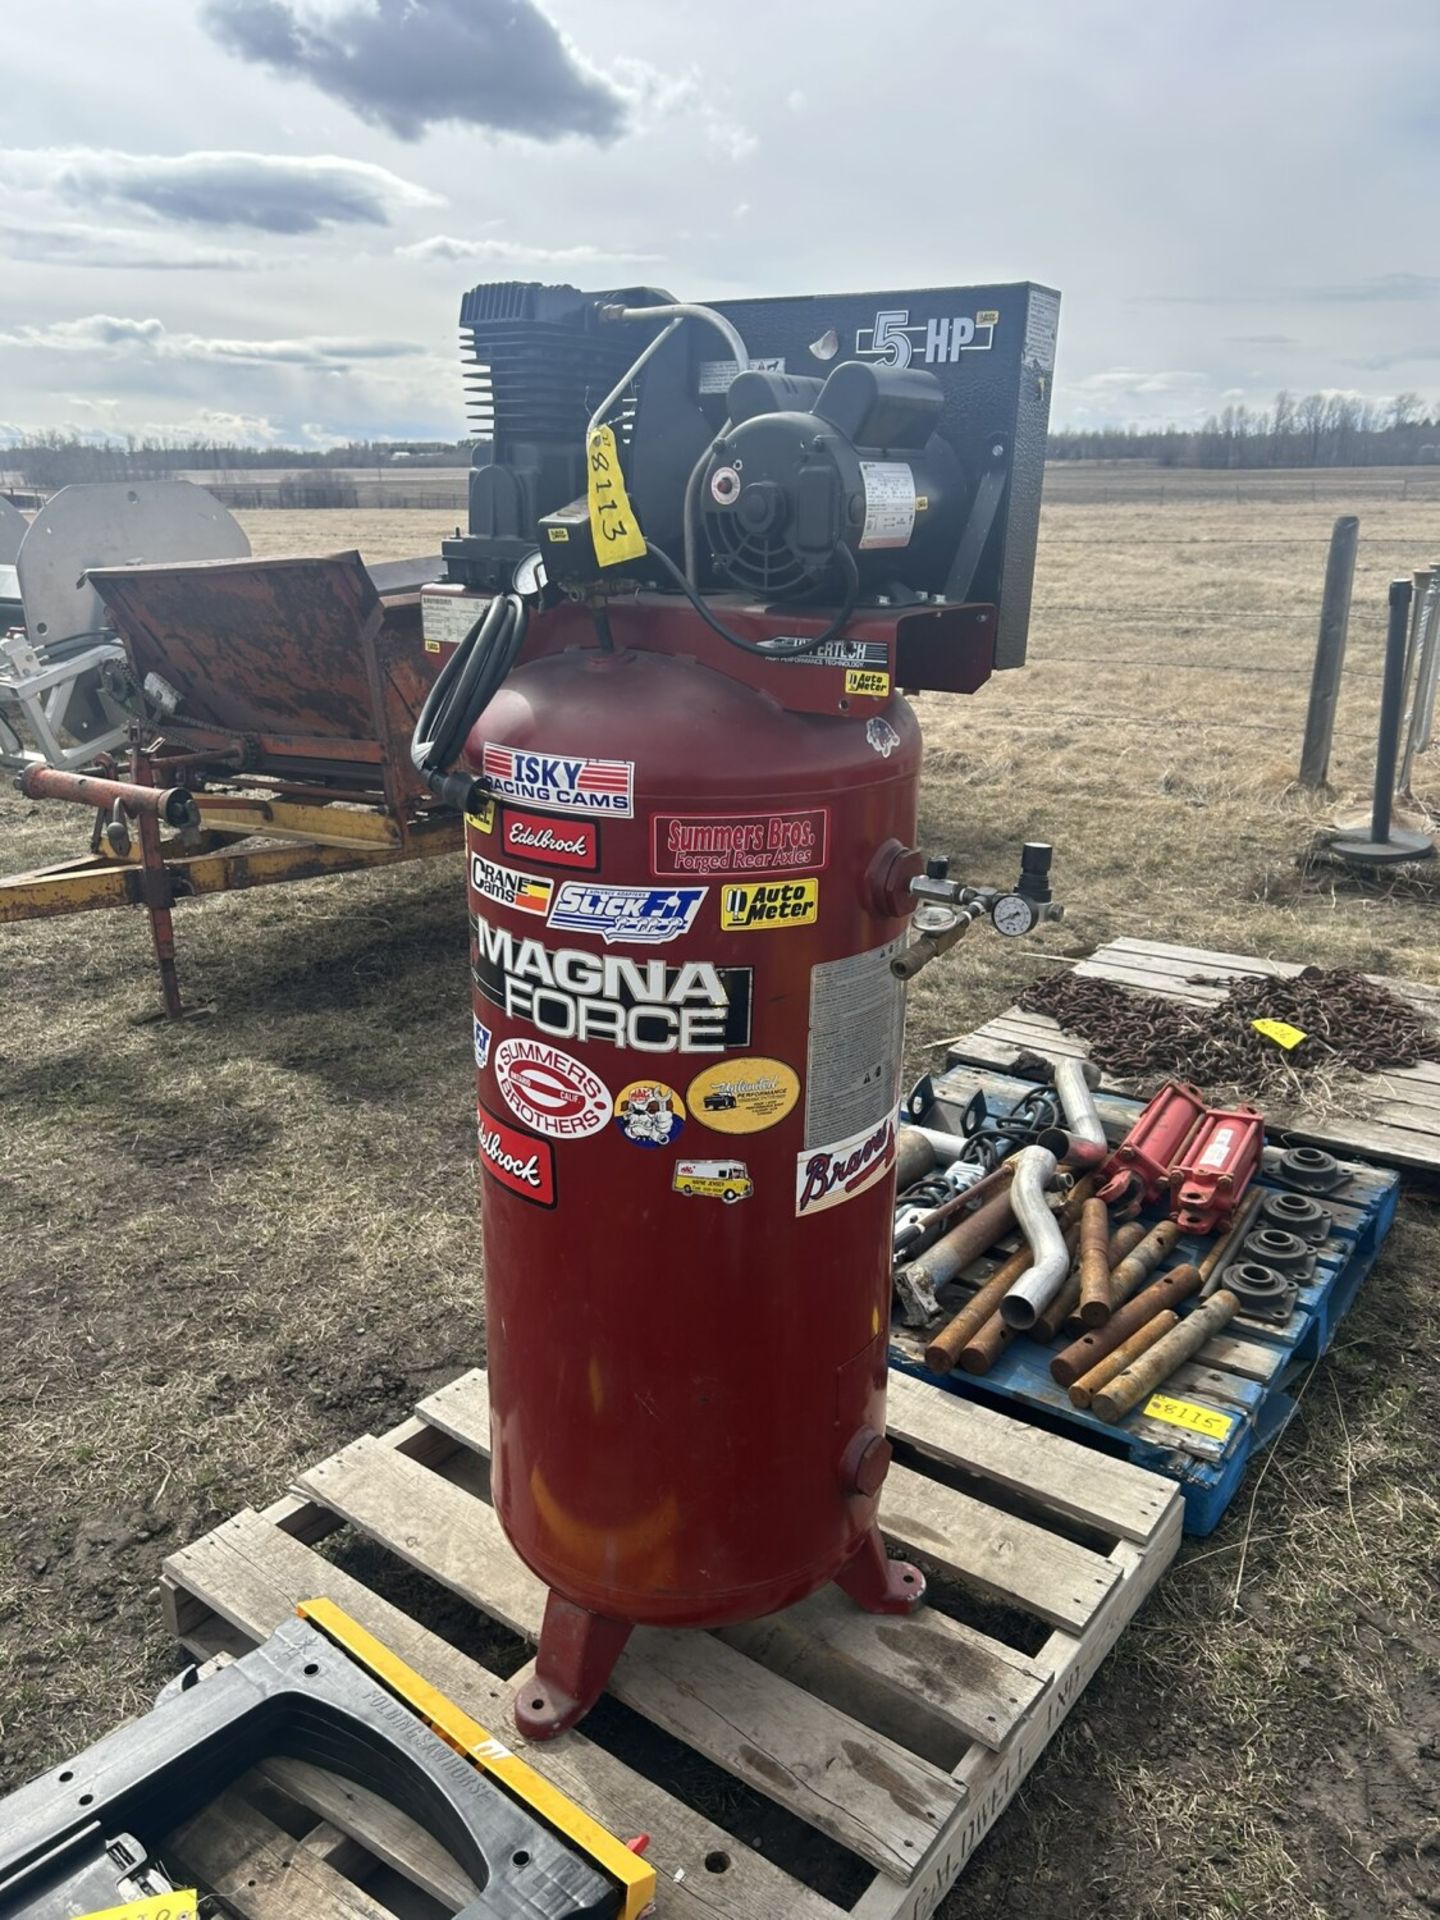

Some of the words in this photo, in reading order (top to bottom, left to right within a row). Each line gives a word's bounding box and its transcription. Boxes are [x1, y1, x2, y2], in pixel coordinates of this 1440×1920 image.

[872, 310, 912, 369] 5
[925, 317, 975, 363] HP
[591, 452, 627, 541] 8113
[856, 682, 887, 692] Meter
[859, 673, 883, 683] Auto
[514, 754, 582, 790] ISKY
[556, 790, 628, 809] CAMS
[508, 822, 587, 856] Edelbrock
[668, 819, 765, 852] Summers
[767, 817, 815, 850] Bros.
[473, 856, 530, 894] CRANE
[674, 851, 731, 874] Forged
[732, 851, 771, 869] Rear
[771, 849, 812, 867] Axles
[749, 901, 814, 921] Meter
[753, 885, 806, 904] Auto
[477, 915, 729, 1005] MAGNA
[504, 975, 726, 1052] FORCE
[500, 1042, 601, 1098] SUMMERS
[500, 1077, 600, 1134] BROTHERS
[1164, 1403, 1222, 1428] 8115
